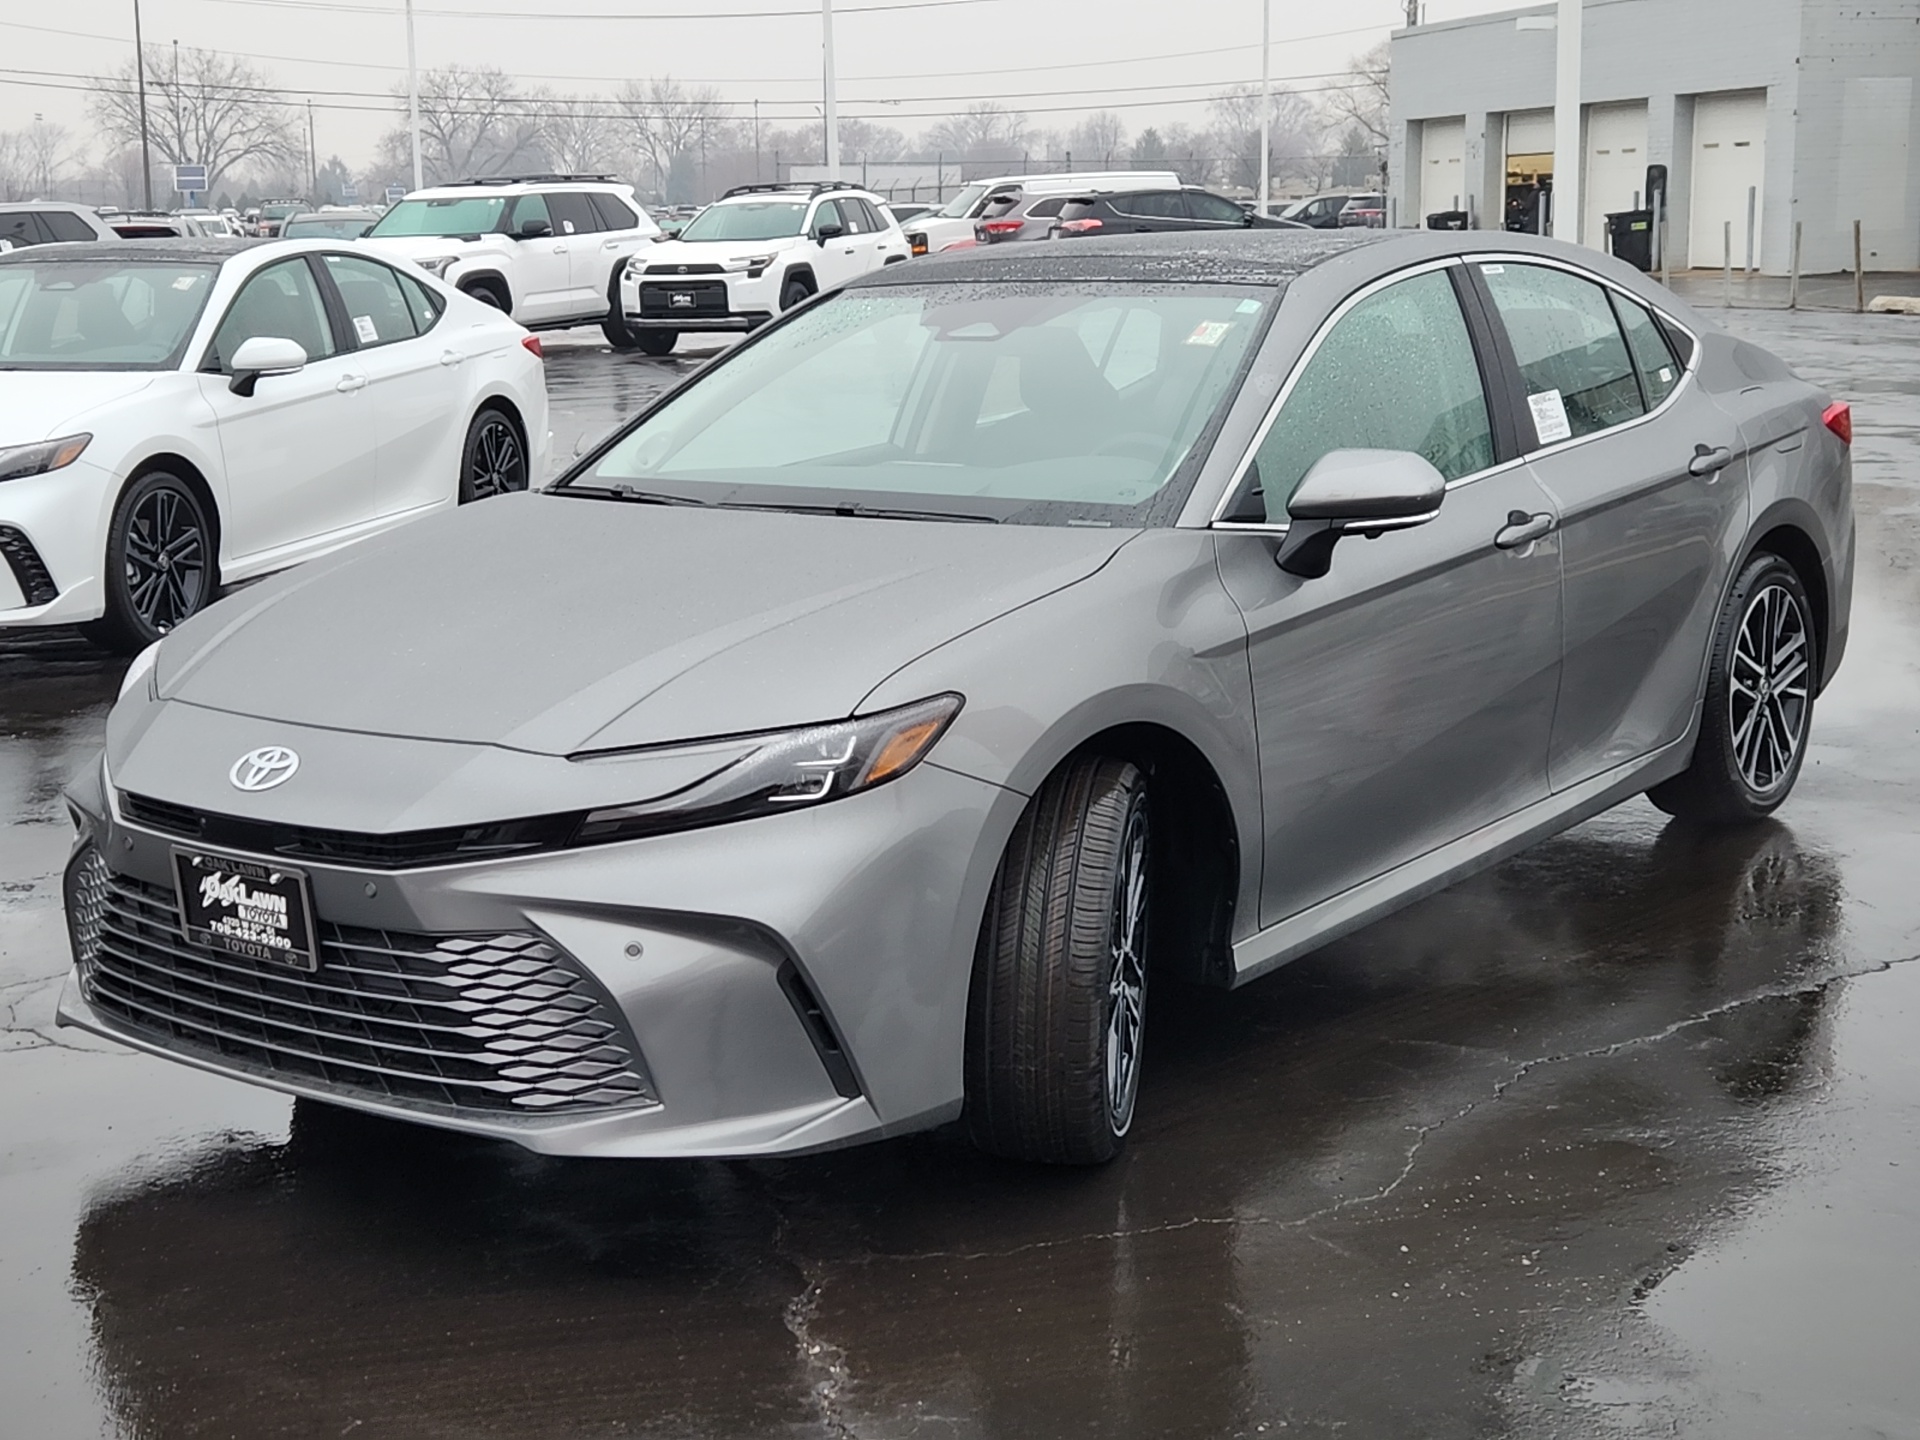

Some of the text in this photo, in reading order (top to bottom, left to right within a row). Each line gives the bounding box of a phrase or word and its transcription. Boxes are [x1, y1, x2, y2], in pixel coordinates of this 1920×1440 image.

[204, 856, 266, 878] OAK LAWN
[243, 905, 282, 925] TOYOTA
[223, 937, 272, 960] TOYOTA
